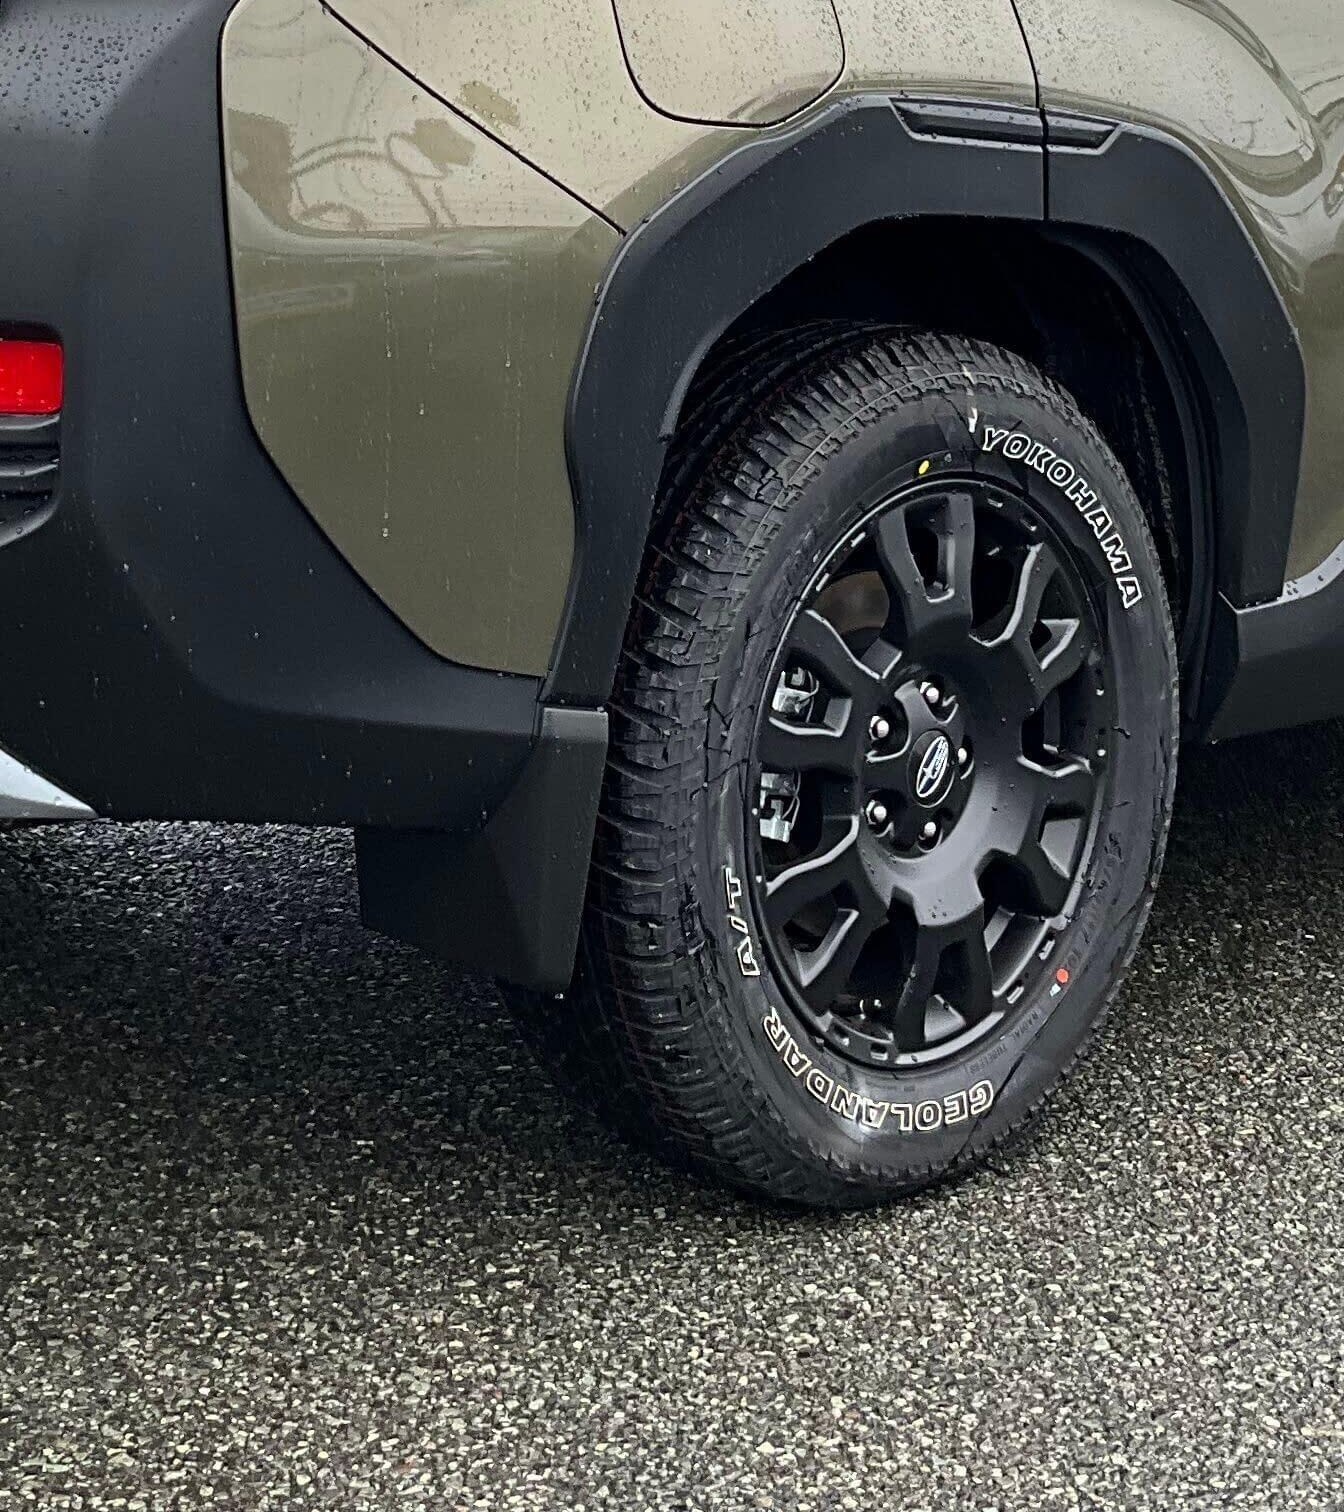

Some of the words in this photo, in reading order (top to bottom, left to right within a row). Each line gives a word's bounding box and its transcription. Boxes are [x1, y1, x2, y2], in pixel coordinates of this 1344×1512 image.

[982, 427, 1143, 609] YOKOHAMA
[724, 867, 761, 976] A/T
[763, 1006, 995, 1132] GEOLANDAR
